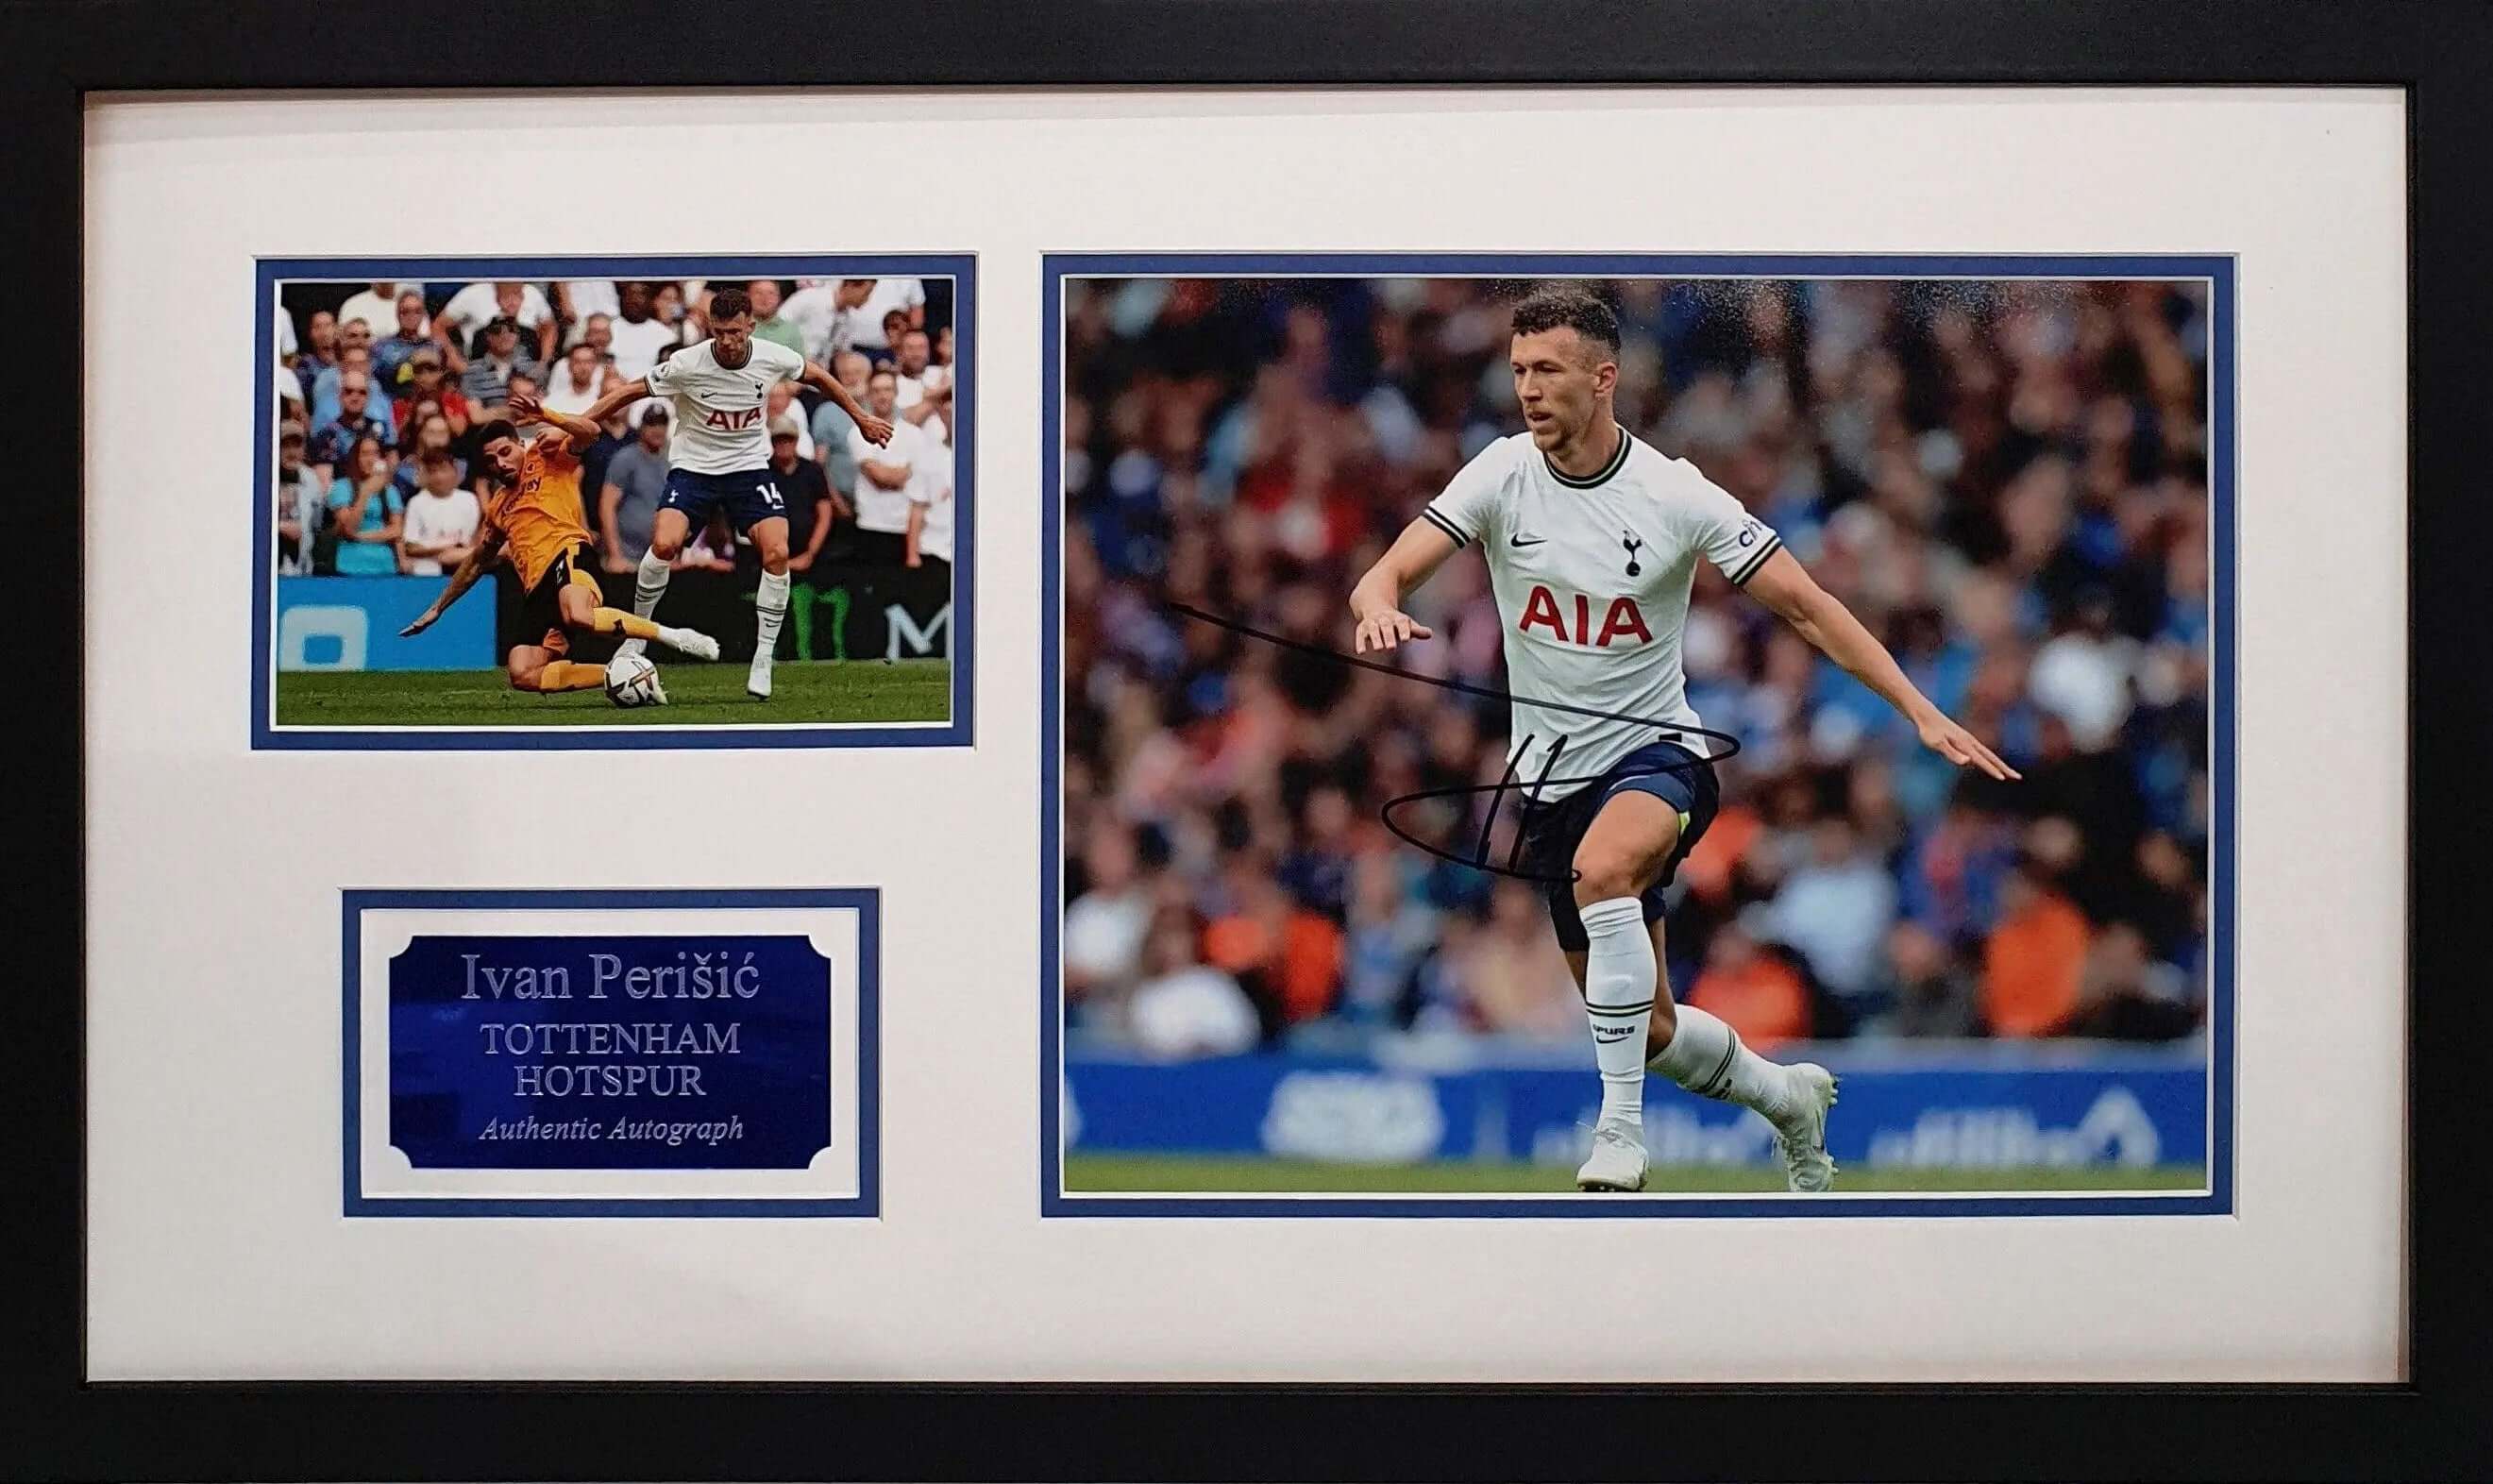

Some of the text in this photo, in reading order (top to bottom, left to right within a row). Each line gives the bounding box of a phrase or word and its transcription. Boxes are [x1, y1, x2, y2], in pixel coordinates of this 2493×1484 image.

[706, 407, 762, 430] AIA
[756, 481, 784, 504] 14
[1519, 585, 1654, 647] AIA
[461, 951, 760, 999] Ivan Perišić
[480, 1023, 741, 1055] TOTTENHAM
[514, 1065, 707, 1097] HOTSPUR
[478, 1115, 745, 1146] Authentic Autograph
